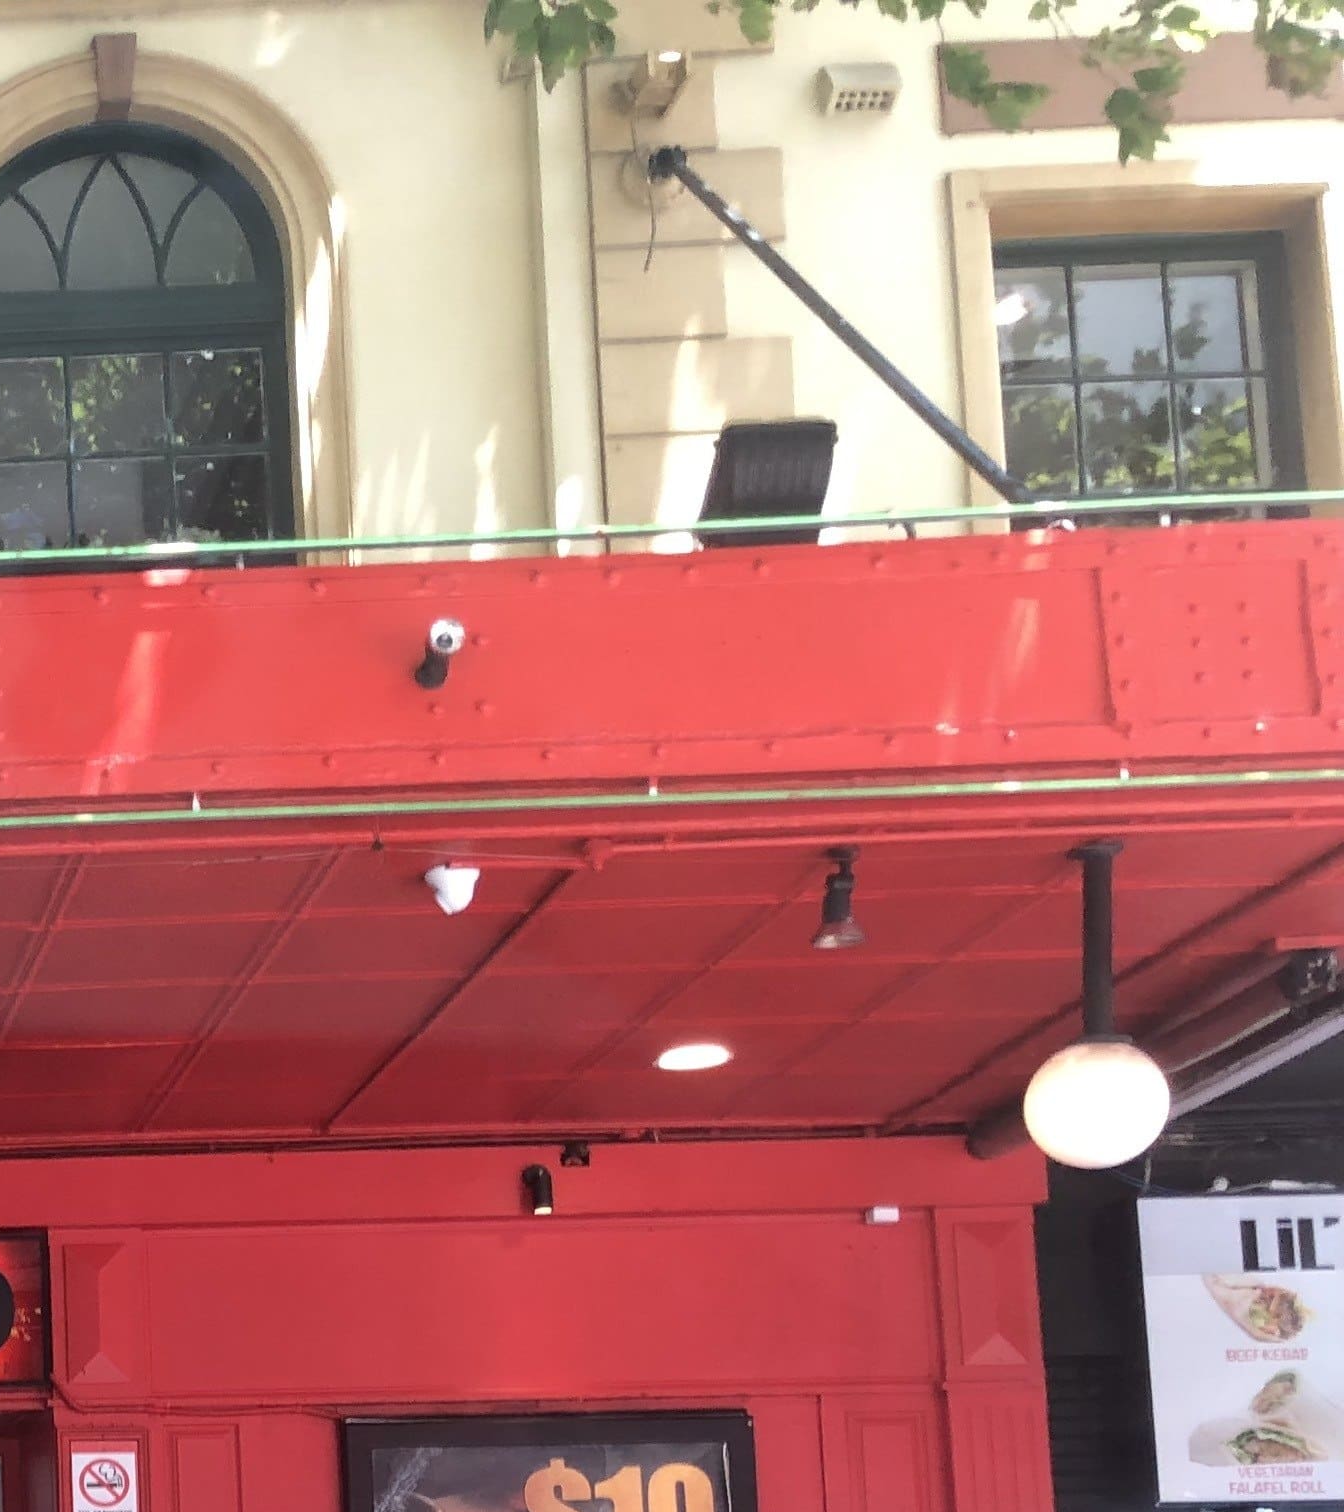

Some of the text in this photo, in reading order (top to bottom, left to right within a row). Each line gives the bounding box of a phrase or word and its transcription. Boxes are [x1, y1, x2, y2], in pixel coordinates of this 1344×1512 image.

[1226, 1349, 1258, 1361] BEEF
[1229, 1481, 1324, 1494] FALAFEL ROLL
